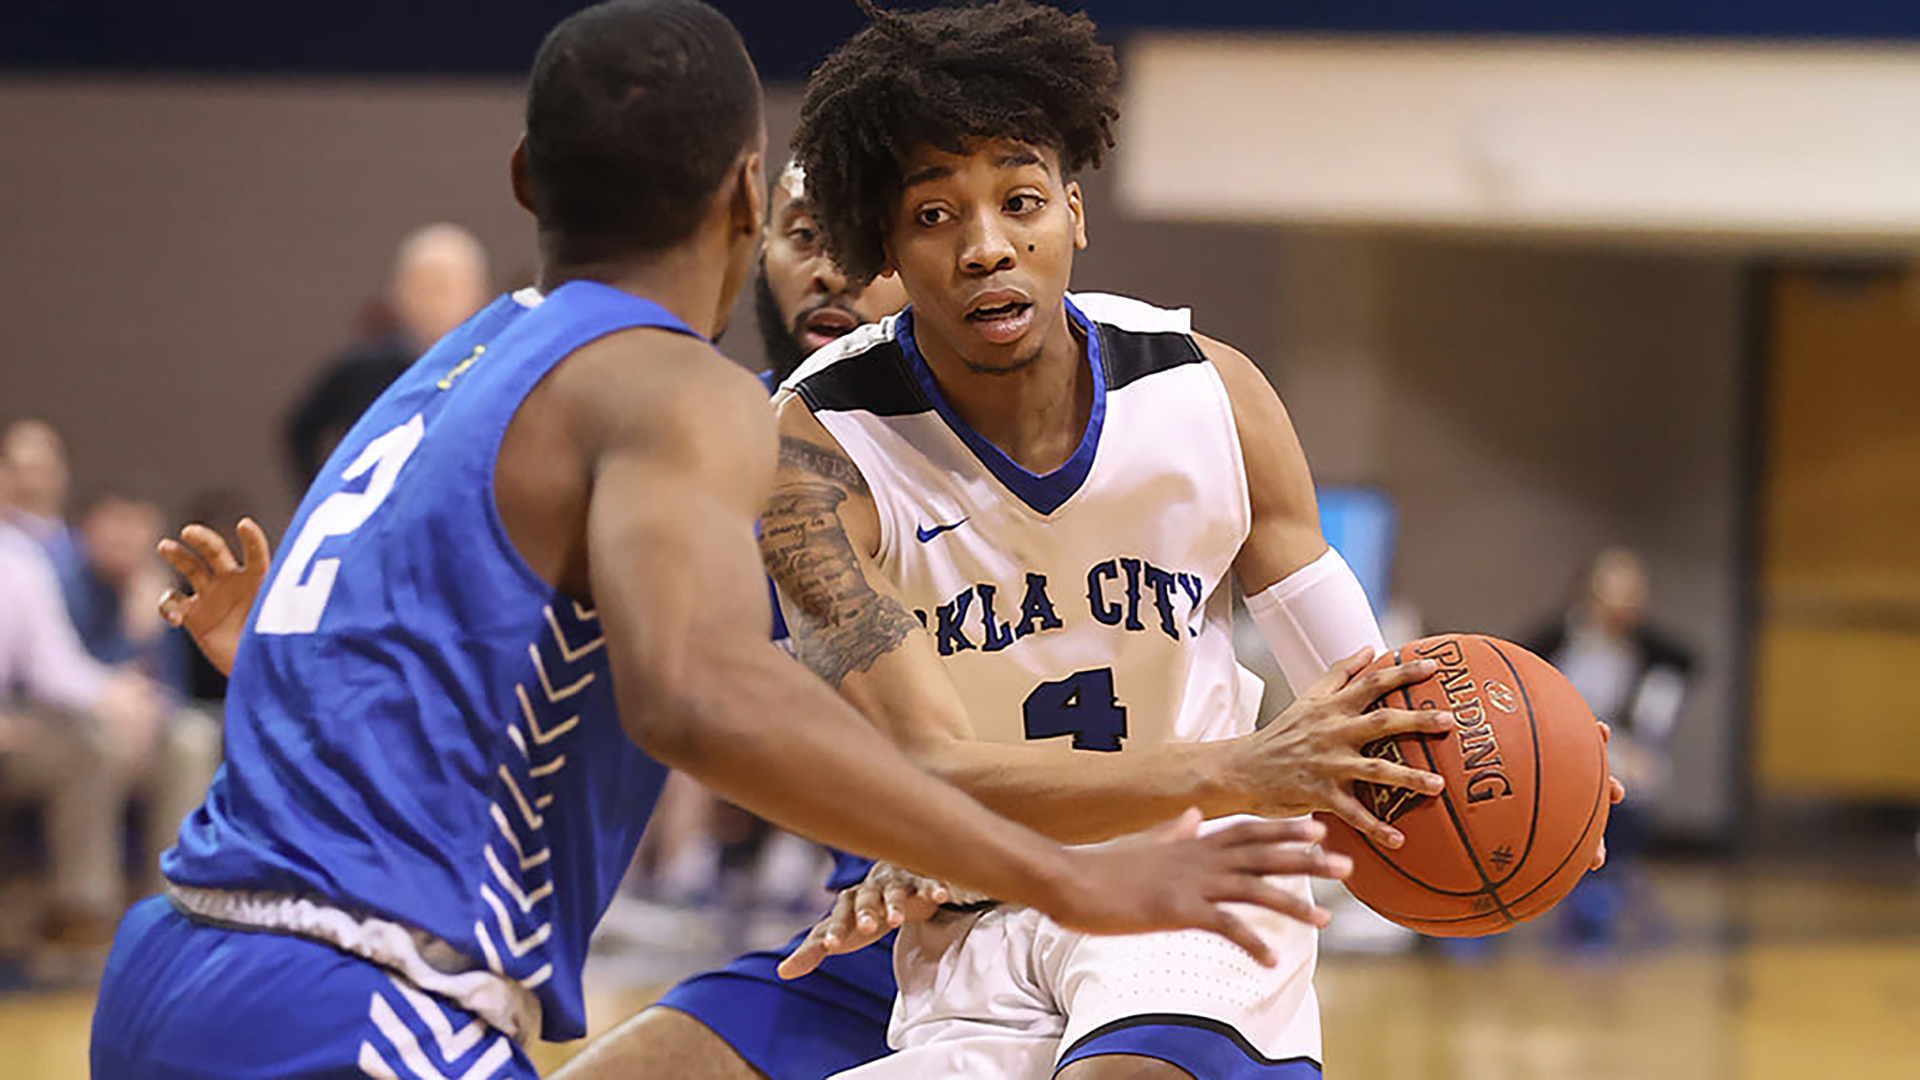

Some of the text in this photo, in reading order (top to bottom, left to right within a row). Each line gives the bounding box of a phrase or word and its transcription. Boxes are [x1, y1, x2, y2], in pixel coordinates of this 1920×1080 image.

[255, 412, 426, 635] 2
[915, 557, 1202, 656] KLA CITY
[1023, 666, 1127, 752] 4
